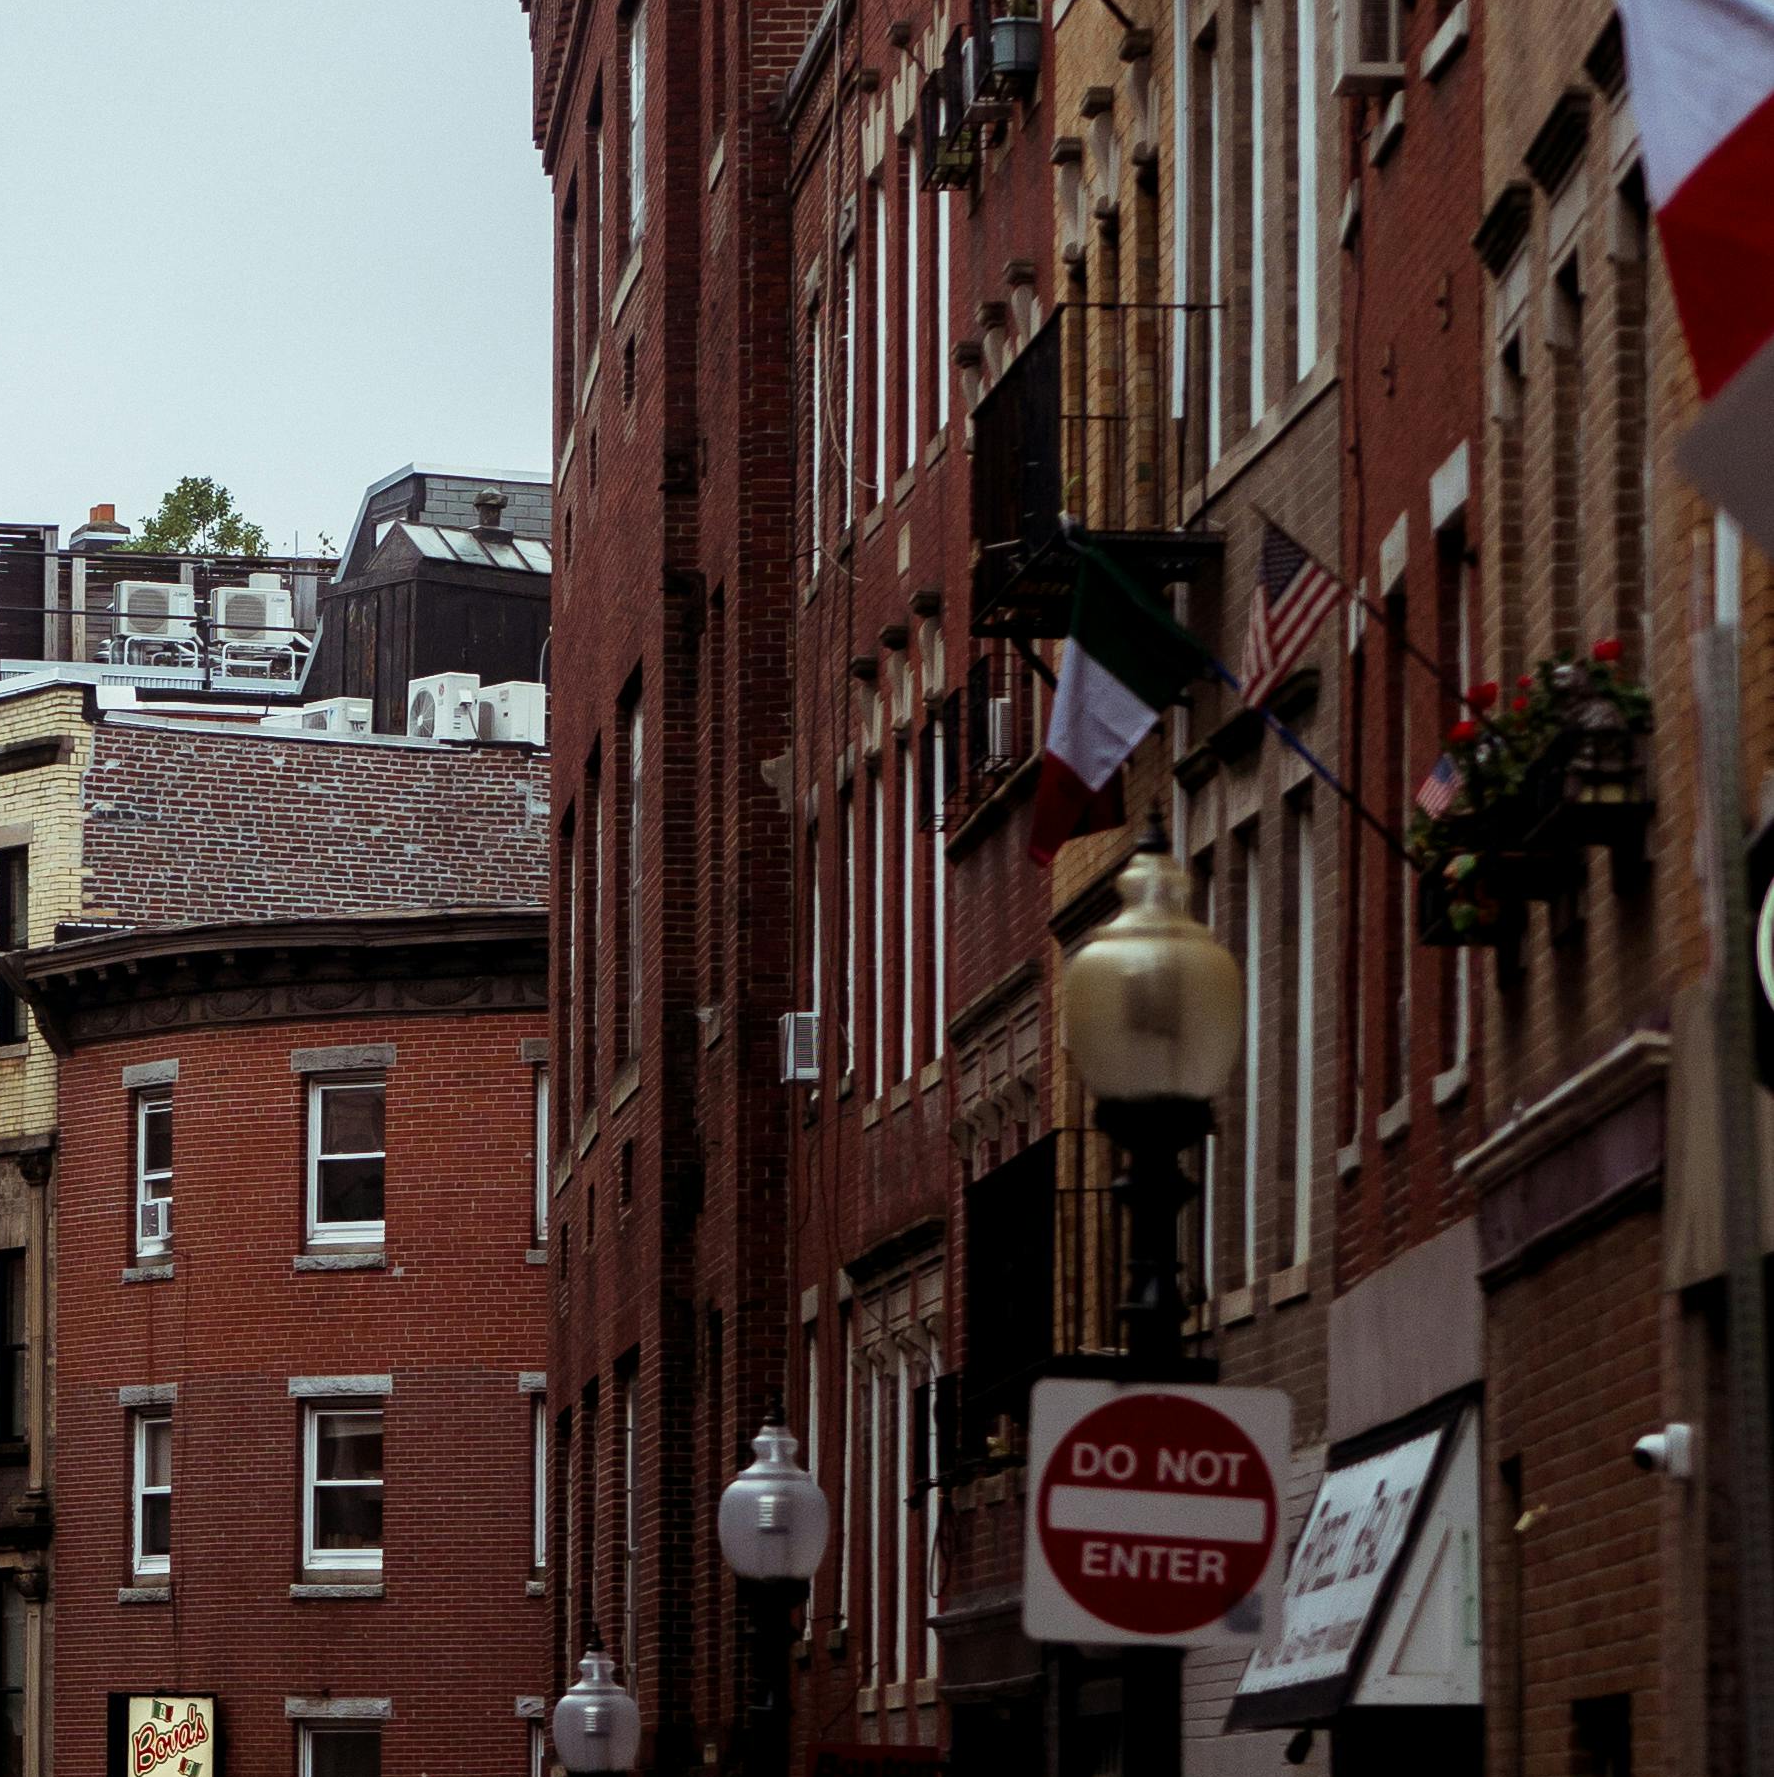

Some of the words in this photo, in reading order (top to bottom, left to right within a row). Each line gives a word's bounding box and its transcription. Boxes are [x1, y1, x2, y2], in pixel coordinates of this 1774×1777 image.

[1071, 1441, 1138, 1481] DO
[1156, 1447, 1248, 1487] NOT
[1080, 1540, 1227, 1585] ENTER
[132, 1703, 209, 1777] Bova's
